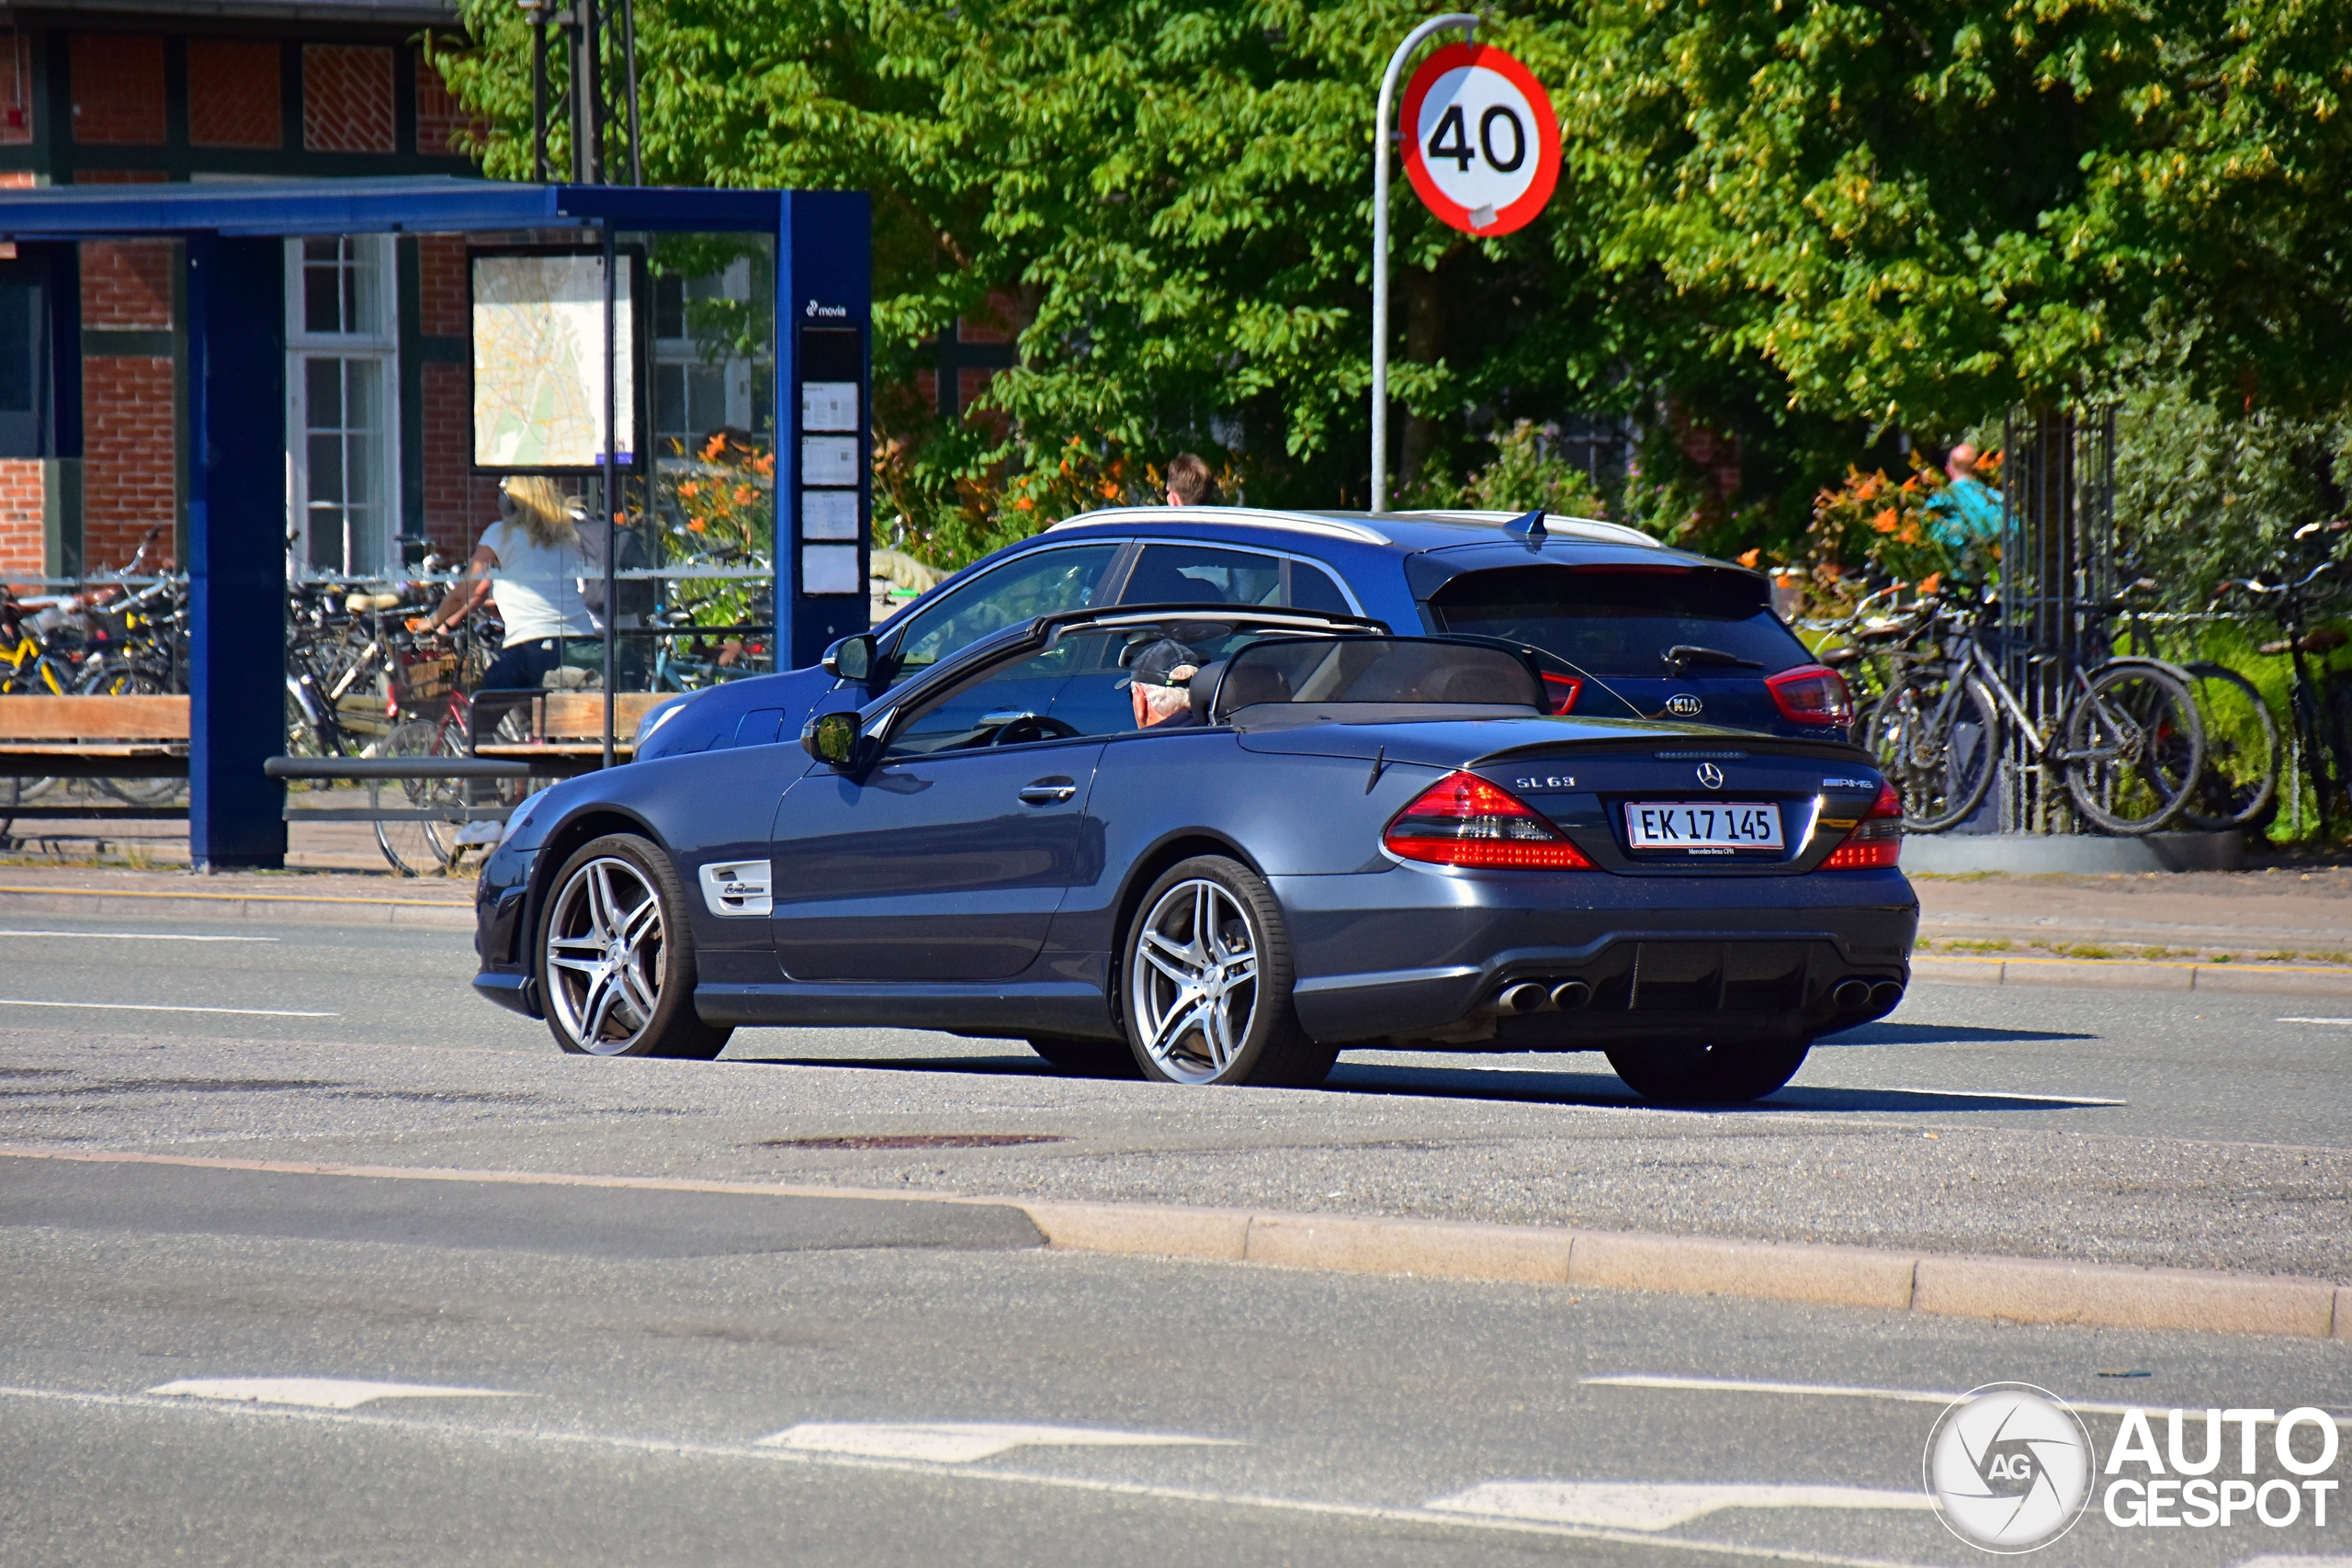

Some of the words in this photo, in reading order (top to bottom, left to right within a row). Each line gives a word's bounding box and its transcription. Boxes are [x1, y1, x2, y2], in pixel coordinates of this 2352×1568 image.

[1427, 104, 1526, 174] 40
[818, 304, 846, 318] movia
[1673, 698, 1698, 712] KIA
[1516, 776, 1544, 788] SL
[1546, 776, 1576, 788] 63
[1838, 778, 1874, 789] AMG
[1641, 809, 1679, 840] EK
[1685, 809, 1715, 840] 17
[1724, 809, 1770, 840] 145
